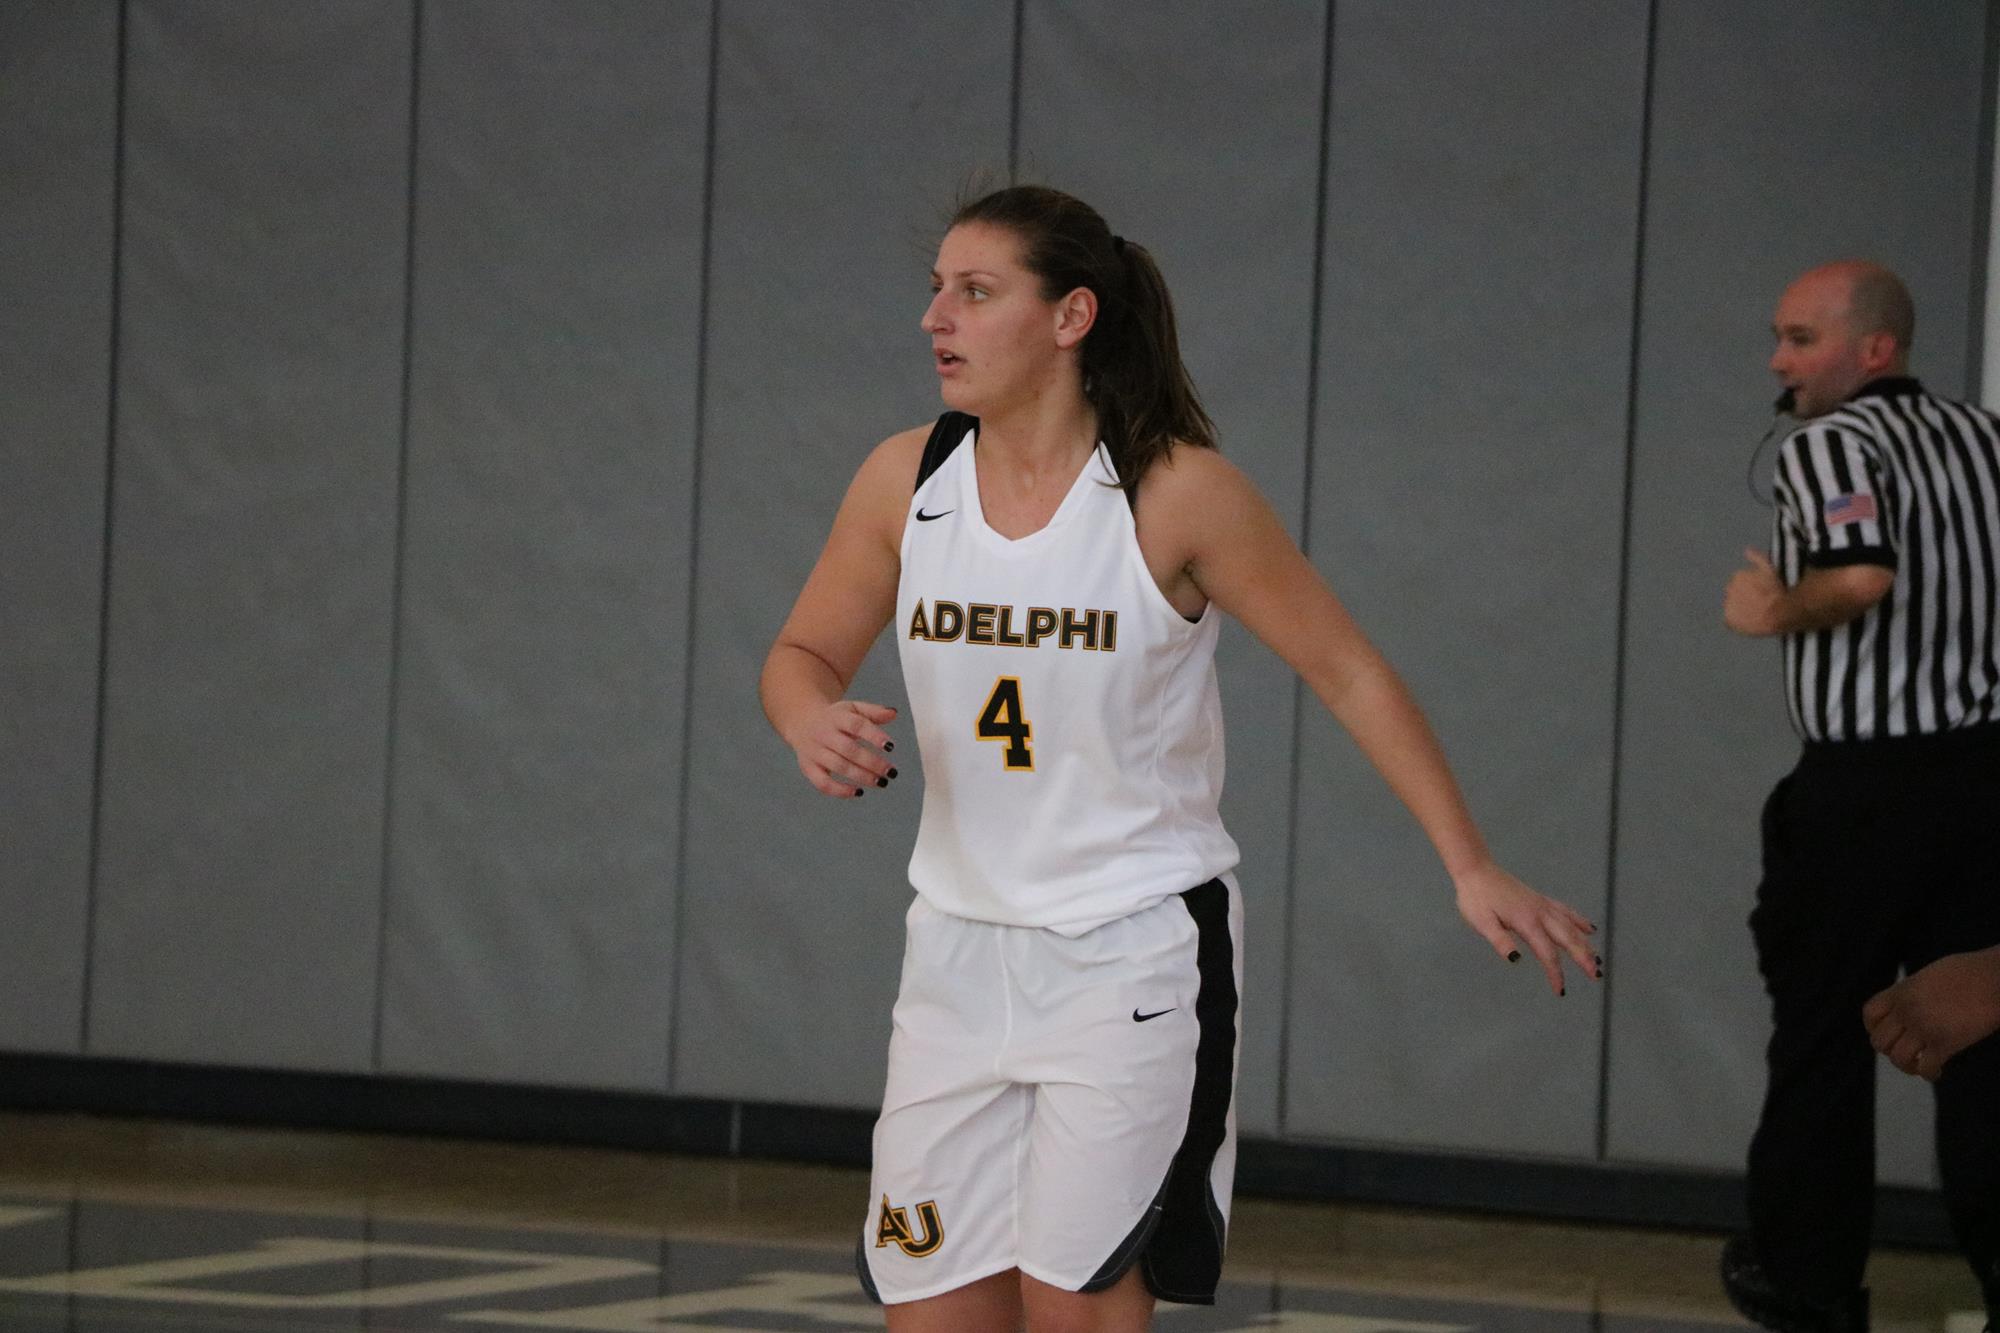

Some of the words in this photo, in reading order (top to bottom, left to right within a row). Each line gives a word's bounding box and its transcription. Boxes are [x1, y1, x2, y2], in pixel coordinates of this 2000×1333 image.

[909, 597, 1118, 651] ADELPHI
[975, 675, 1036, 772] 4
[876, 1193, 944, 1257] AU
